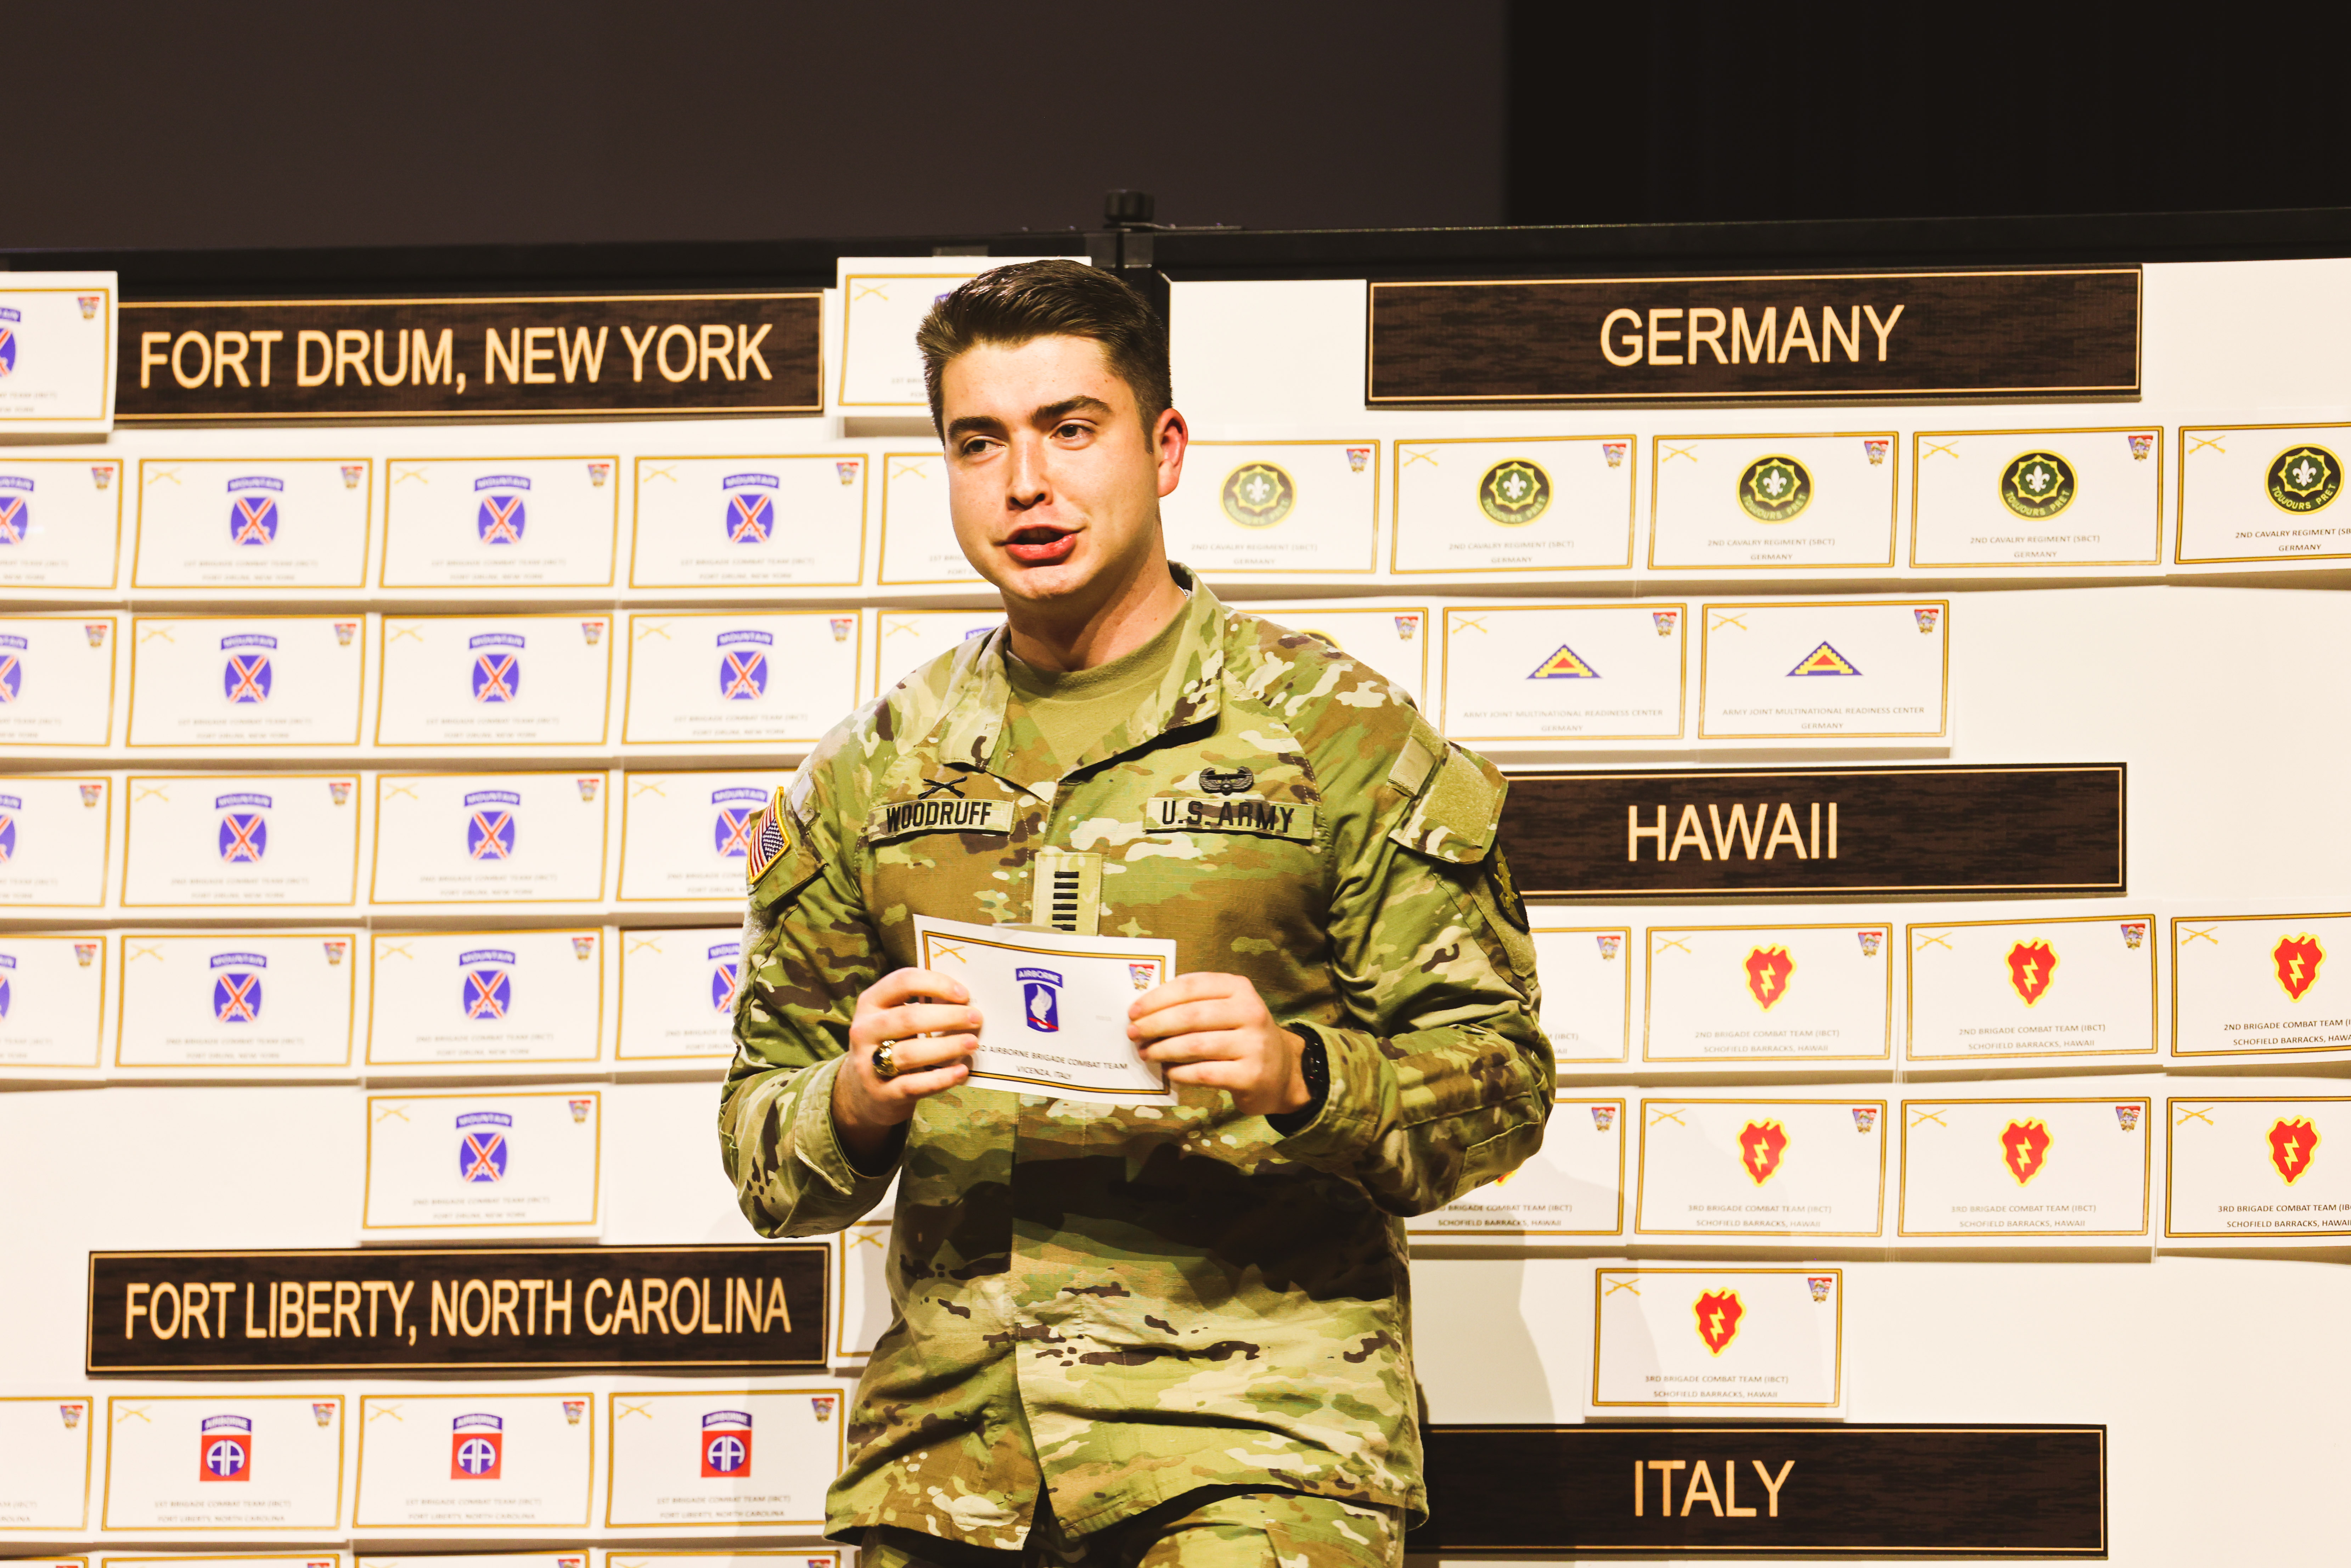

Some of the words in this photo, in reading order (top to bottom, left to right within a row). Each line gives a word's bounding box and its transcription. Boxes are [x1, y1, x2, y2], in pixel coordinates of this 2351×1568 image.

[1601, 305, 1904, 366] GERMANY
[141, 331, 283, 388] FORT
[298, 329, 465, 393] DRUM,
[486, 327, 608, 383] NEW
[621, 324, 772, 382] YORK
[2006, 491, 2046, 516] TOUJOURS
[2049, 490, 2070, 512] PRET
[2272, 485, 2312, 510] TOUJOURS
[2315, 483, 2336, 505] PRET
[887, 802, 992, 832] WOODRUFF
[1162, 800, 1210, 825] U.S.
[1218, 801, 1294, 833] ARMY
[1629, 803, 1837, 861] HAWAII
[1018, 970, 1060, 984] AIRBORNE
[2081, 1024, 2105, 1032] (IBCT)
[990, 1046, 1029, 1058] AIRBORNE
[1031, 1052, 1064, 1063] BRIGADE
[1068, 1058, 1101, 1068] COMBAT
[1053, 1071, 1072, 1080] ITALY
[126, 1283, 236, 1339] FORT
[246, 1281, 416, 1345] LIBERTY,
[431, 1280, 572, 1336] NORTH
[585, 1278, 791, 1335] CAROLINA
[1636, 1461, 1794, 1516] ITALY
